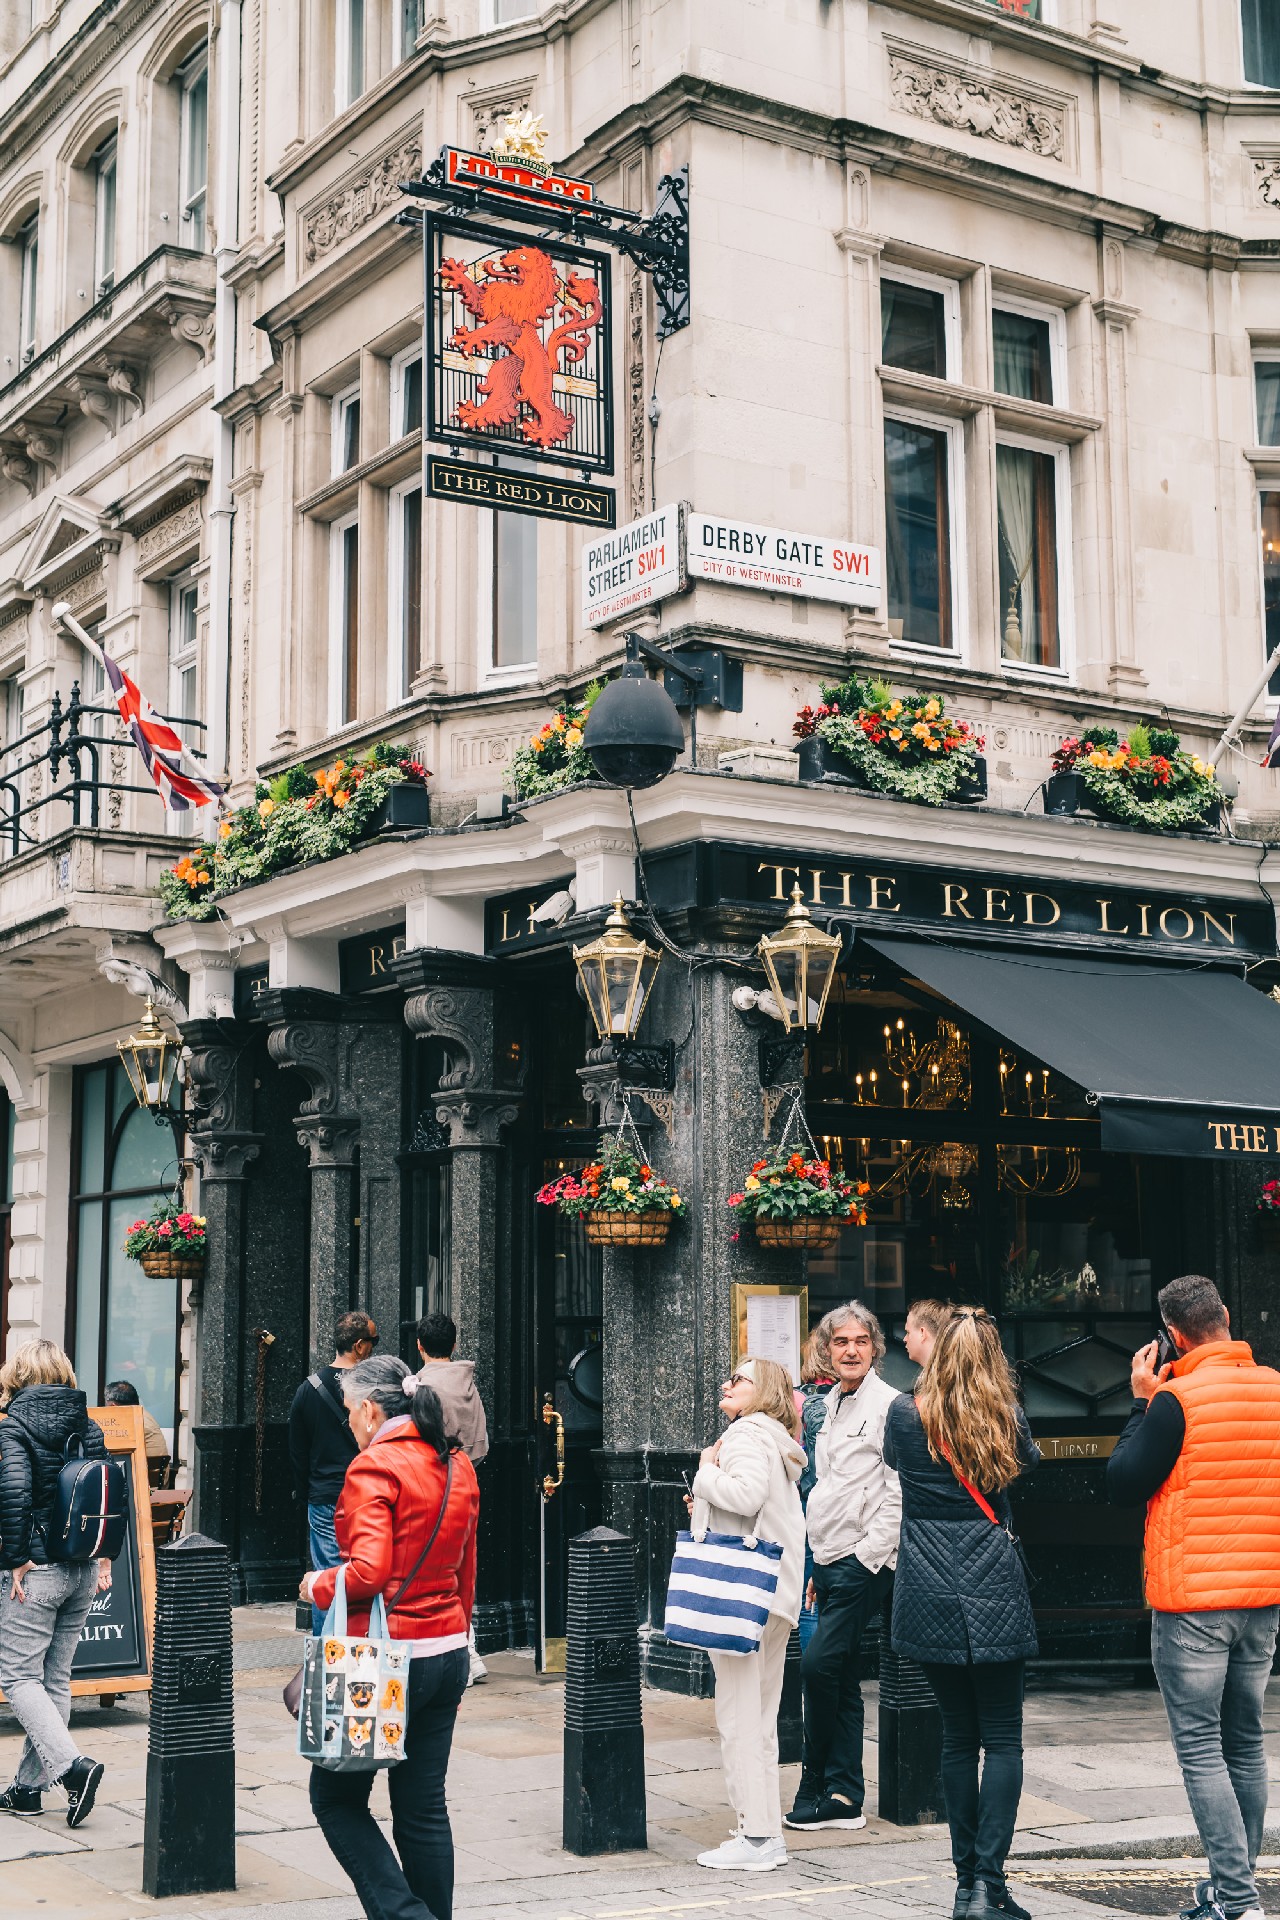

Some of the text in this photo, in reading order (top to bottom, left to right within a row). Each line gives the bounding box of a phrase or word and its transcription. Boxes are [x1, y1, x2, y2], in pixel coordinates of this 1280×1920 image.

[438, 471, 602, 514] THE RED LION
[589, 516, 666, 572] PARLIAMENT
[703, 524, 870, 576] DERBY GATE SW1
[589, 544, 665, 598] STREET SW1
[703, 561, 802, 588] CITY OF WESTMINSTER
[589, 586, 652, 622] CITY OF WESTMINSTER
[758, 863, 1237, 945] THE RED LION
[369, 936, 406, 976] RE
[1208, 1121, 1269, 1153] THE
[79, 1624, 125, 1642] LITY
